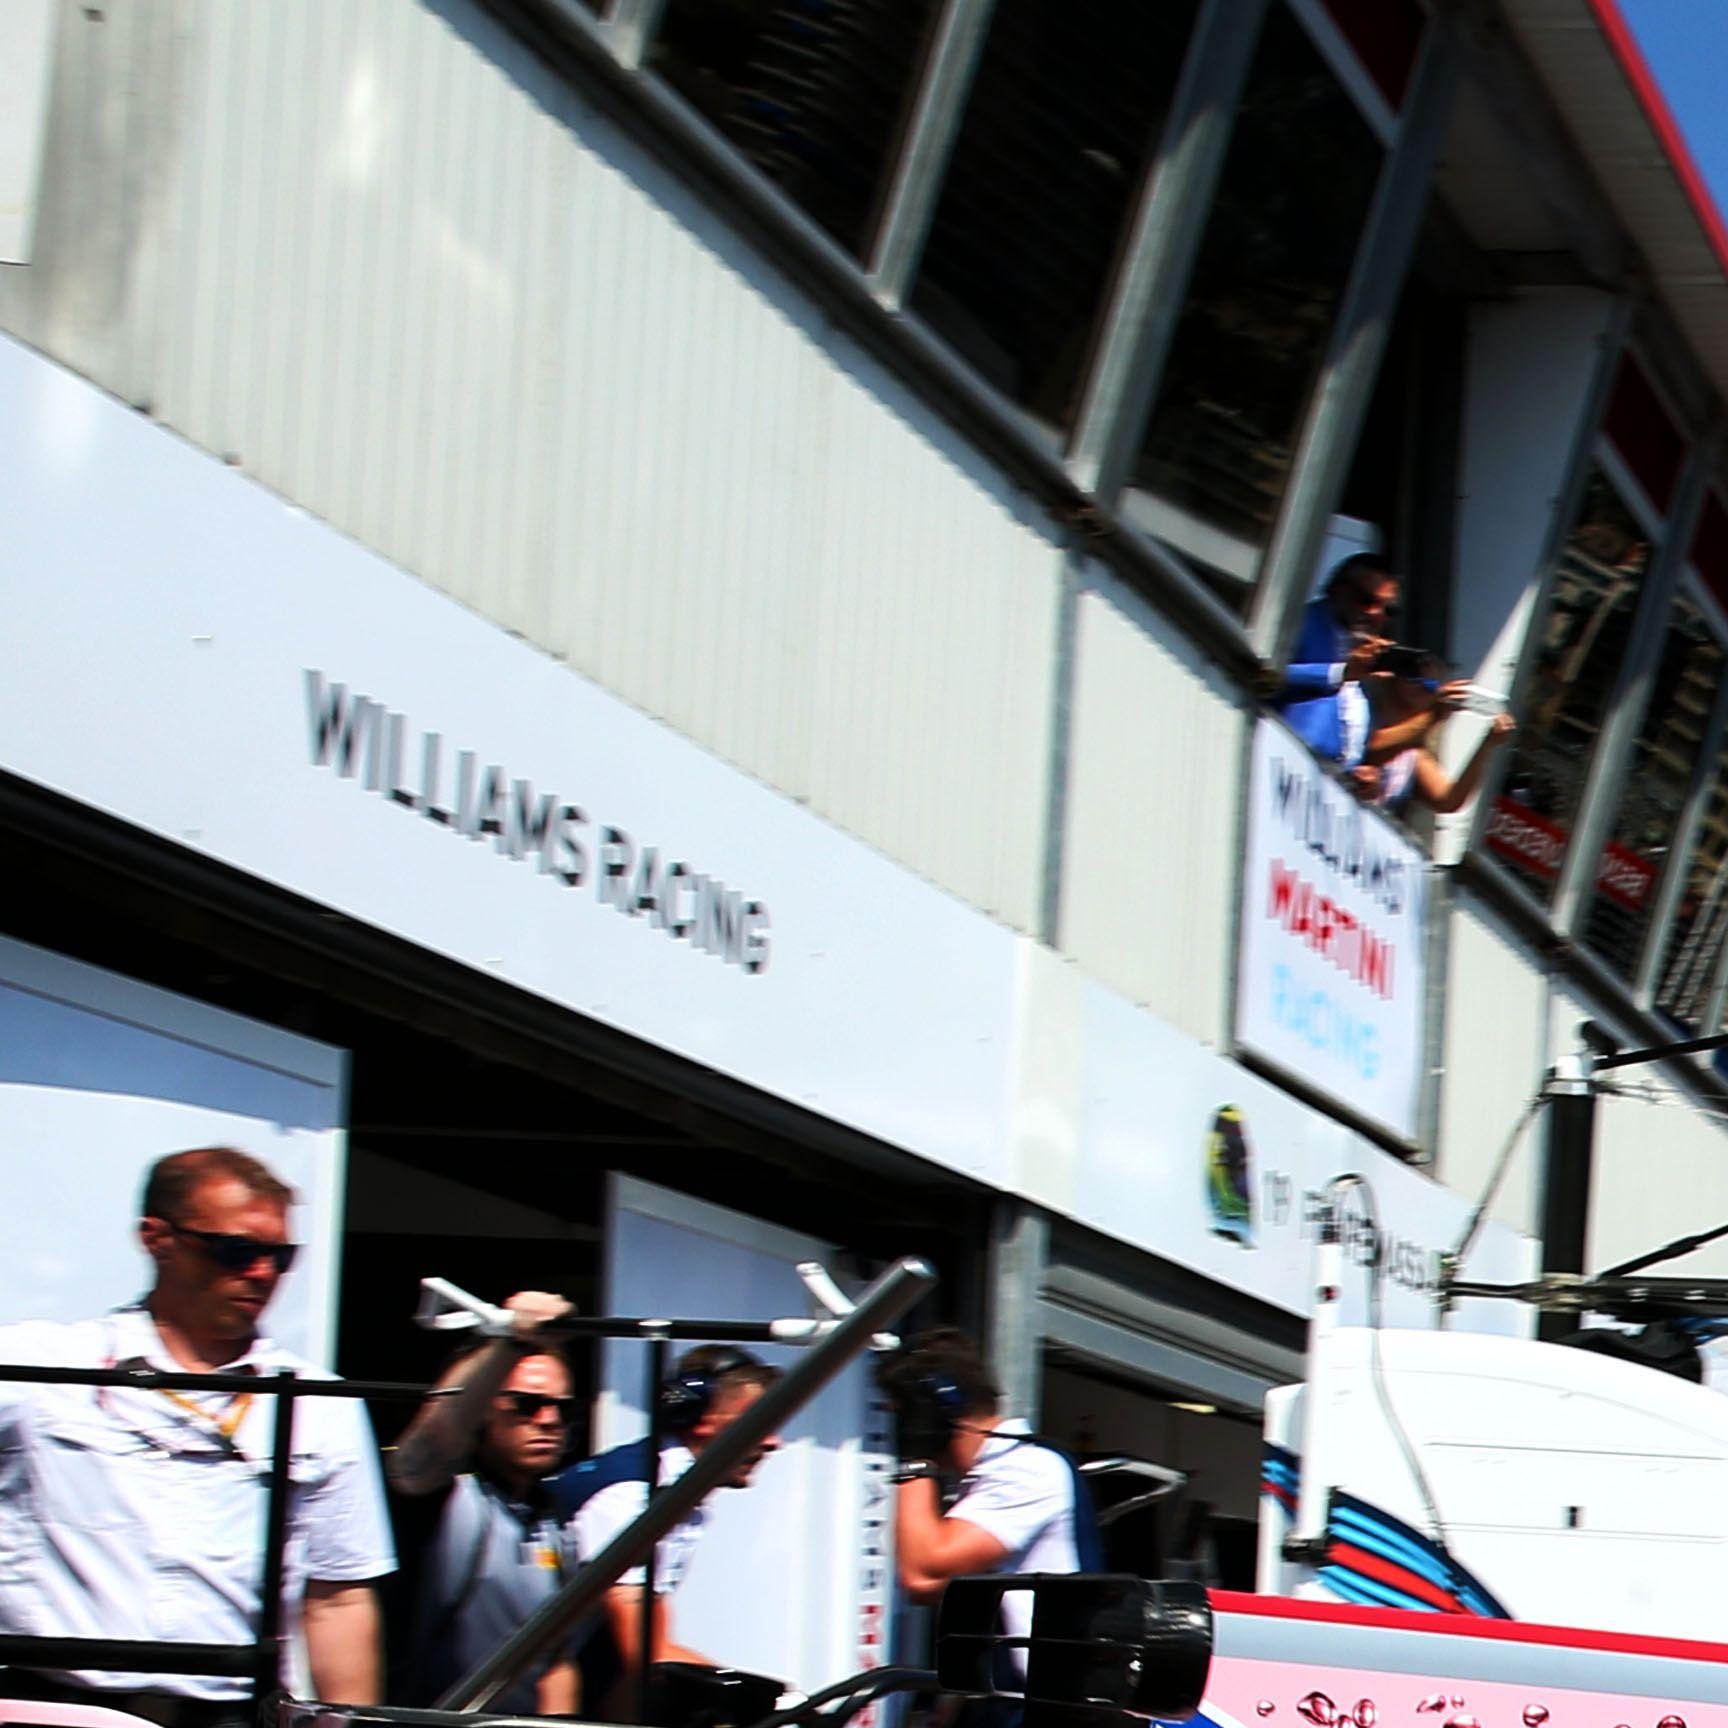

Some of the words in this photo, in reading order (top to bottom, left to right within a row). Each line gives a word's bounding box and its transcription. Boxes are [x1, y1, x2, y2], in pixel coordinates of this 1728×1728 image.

[303, 668, 586, 888] WILLIAMS
[596, 824, 773, 976] RACING
[1265, 857, 1396, 1002] MARTINI
[1268, 961, 1380, 1080] RACING
